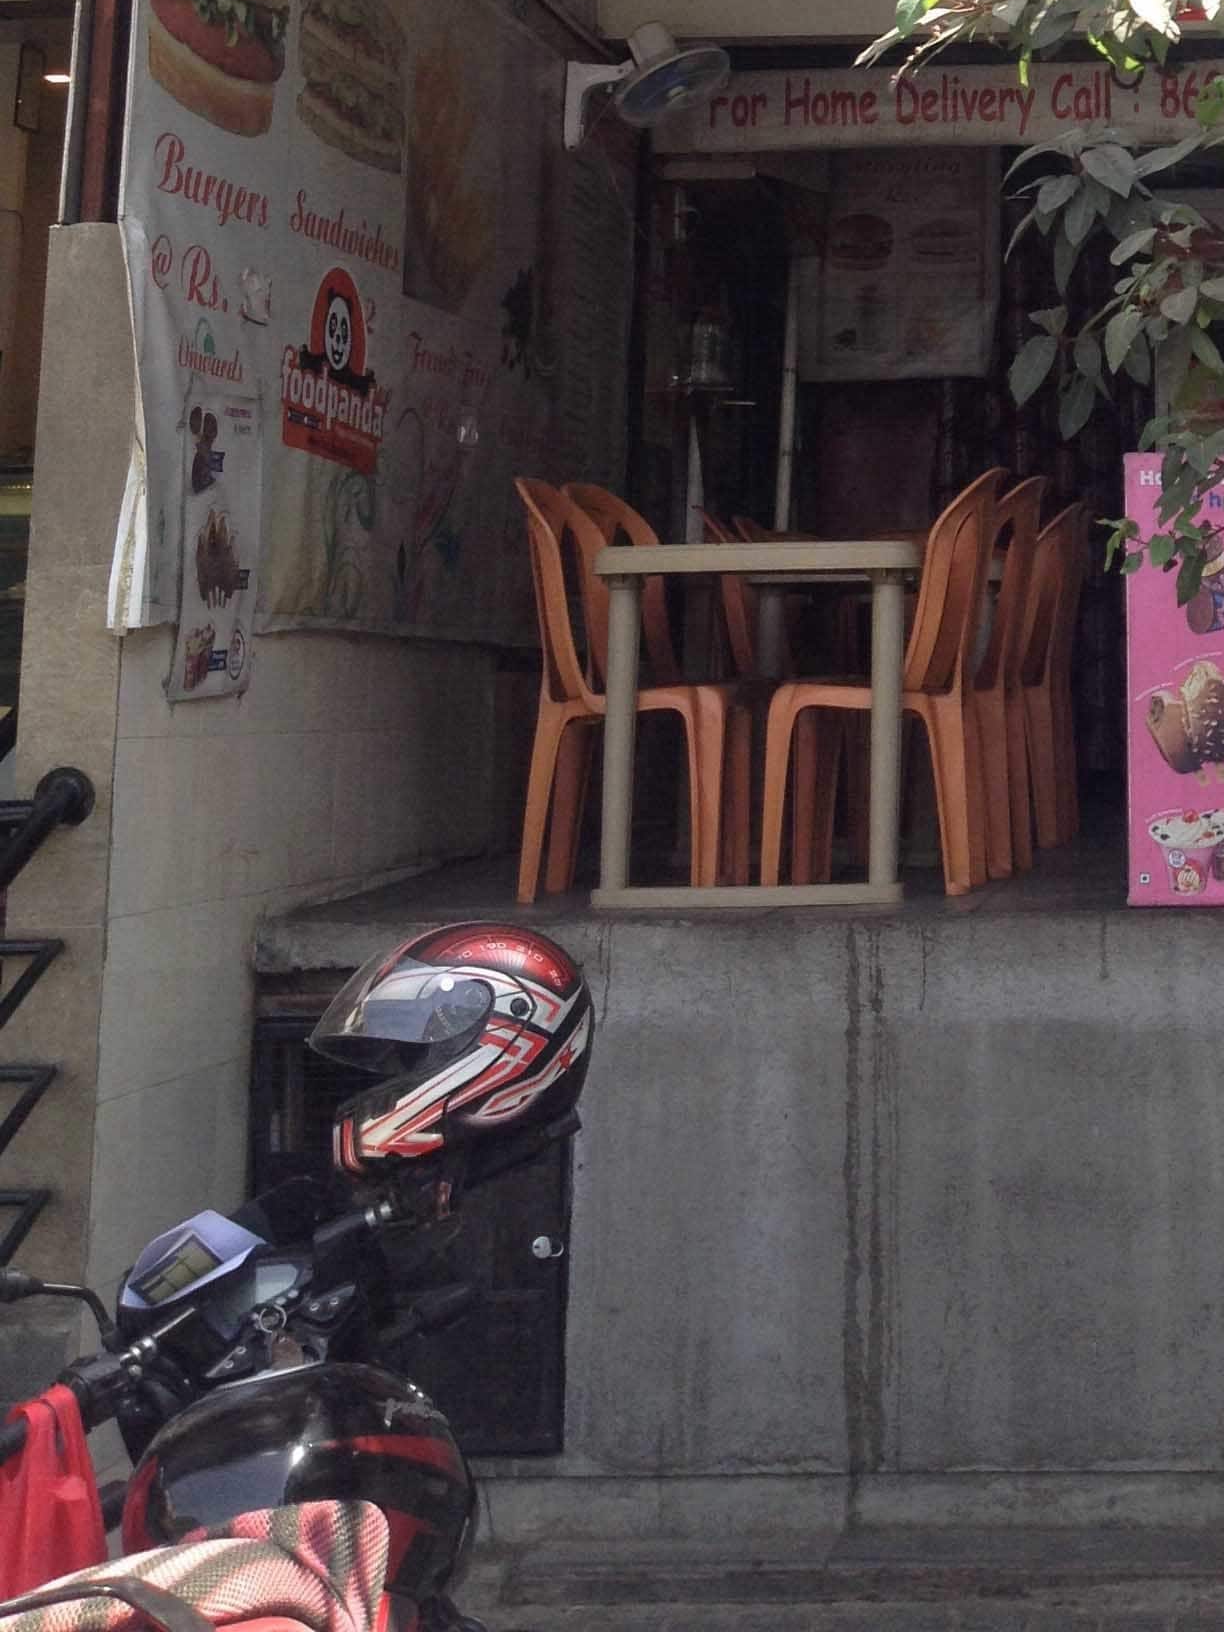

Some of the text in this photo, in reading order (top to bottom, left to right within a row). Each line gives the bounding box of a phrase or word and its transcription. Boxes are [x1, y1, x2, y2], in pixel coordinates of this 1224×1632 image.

[784, 78, 878, 126] Home
[896, 73, 1035, 136] Delivery
[1051, 71, 1111, 121] Call
[154, 132, 269, 229] Burgers
[289, 189, 400, 271] Sandwiches
[281, 345, 385, 438] foodpanda
